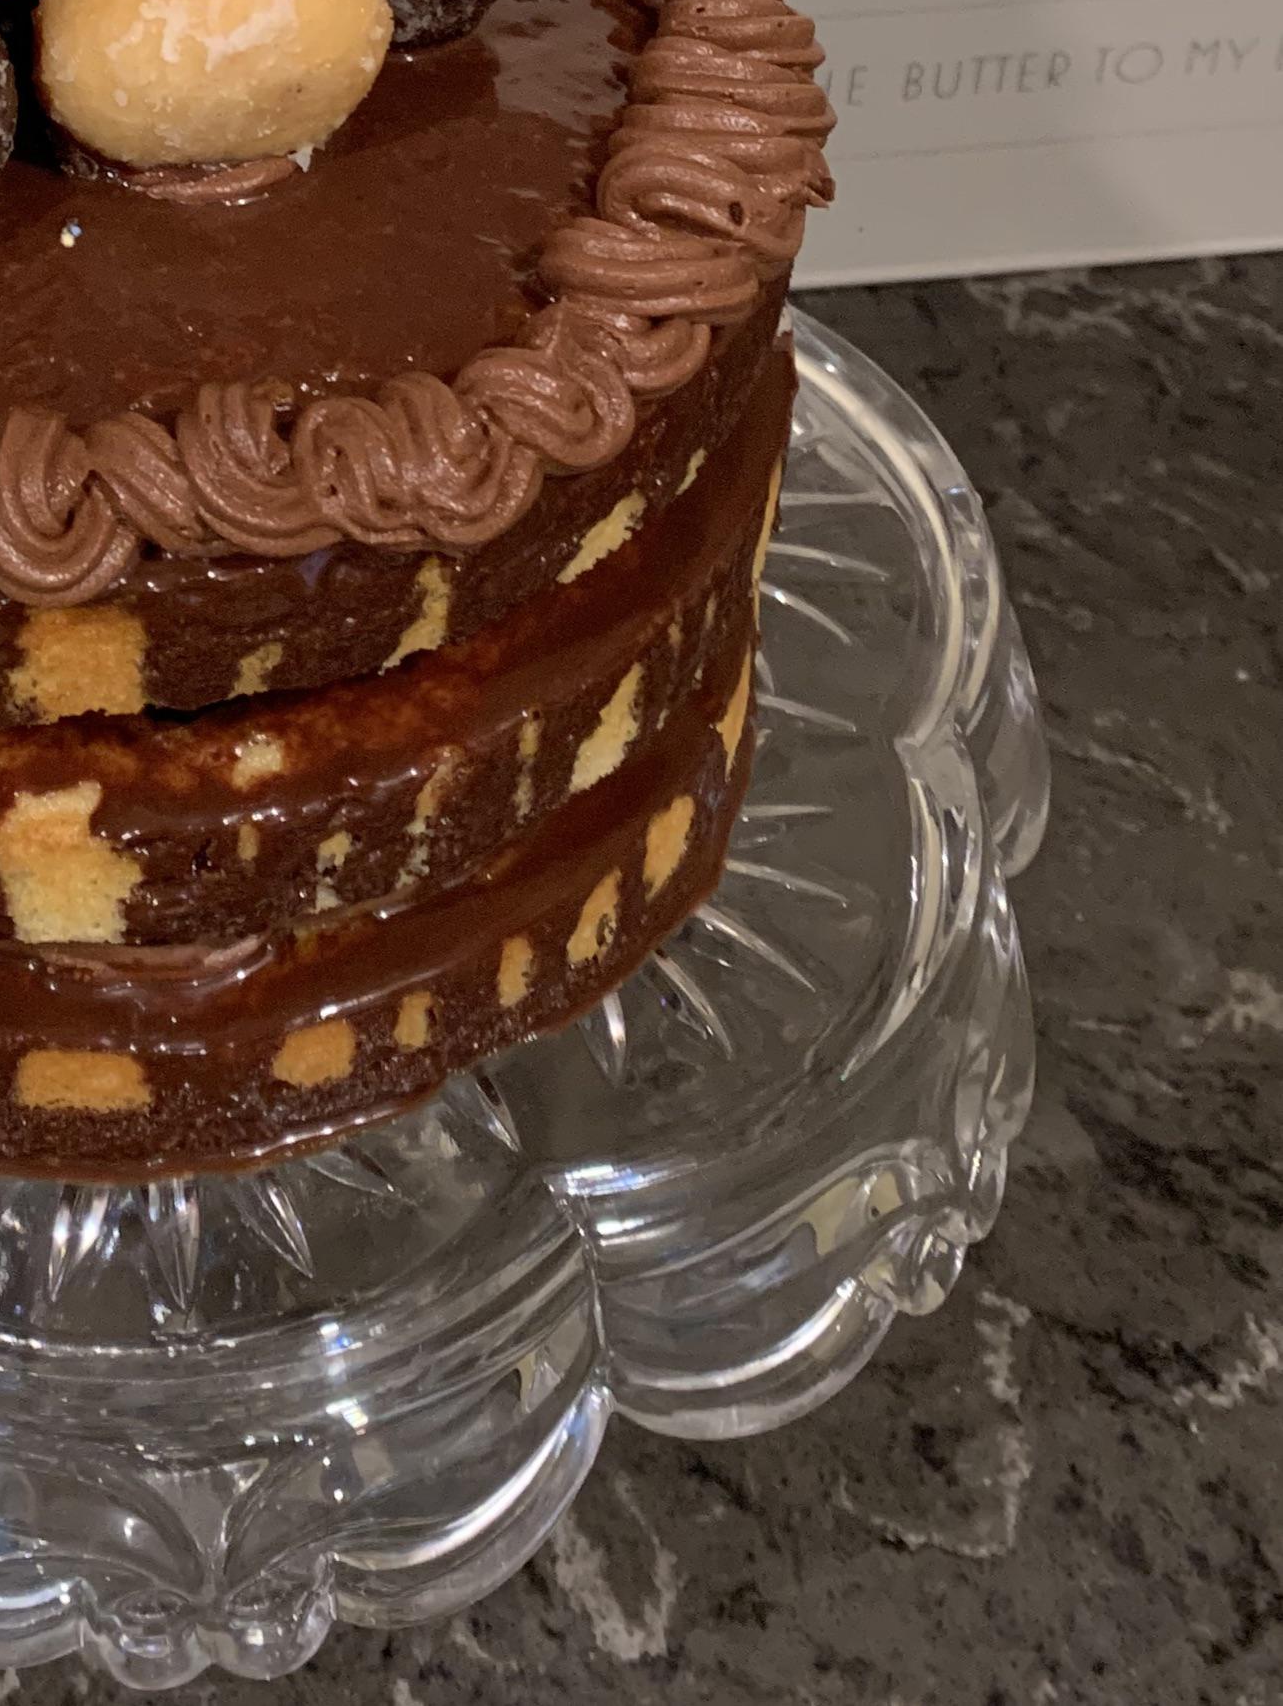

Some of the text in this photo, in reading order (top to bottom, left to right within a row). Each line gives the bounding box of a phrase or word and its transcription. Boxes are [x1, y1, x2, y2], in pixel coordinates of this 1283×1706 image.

[901, 49, 1072, 103] BUTTER
[1094, 41, 1165, 85] TO
[1183, 35, 1261, 77] MY
